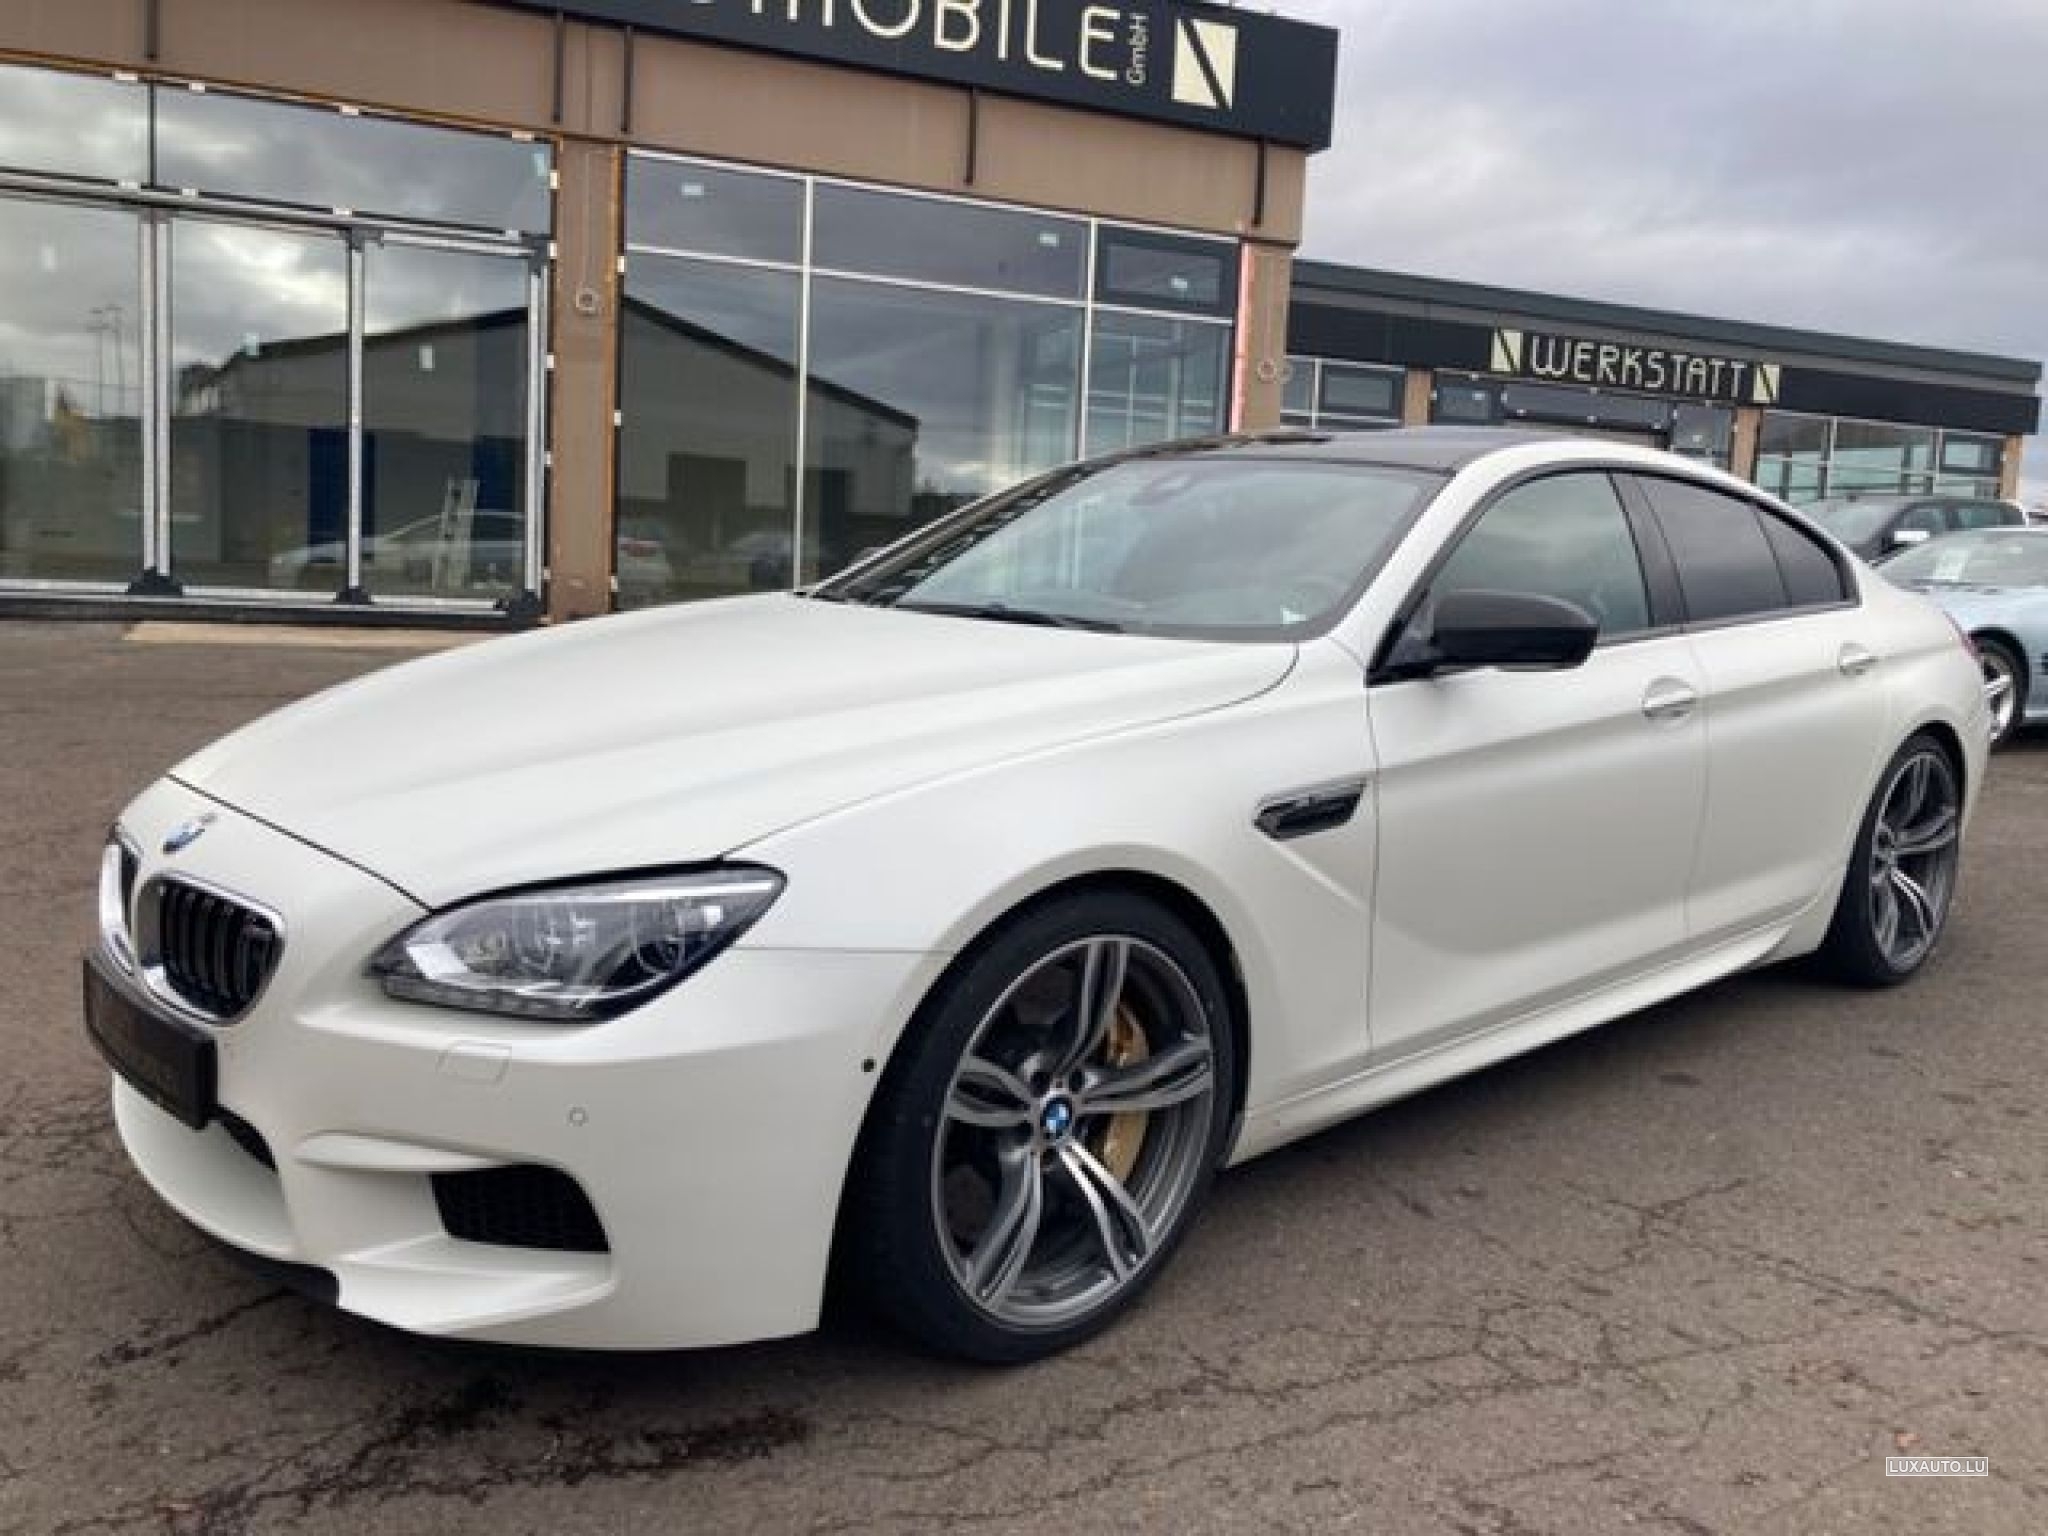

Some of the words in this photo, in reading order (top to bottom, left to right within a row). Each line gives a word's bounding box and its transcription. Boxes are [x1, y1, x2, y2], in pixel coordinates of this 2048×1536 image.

[687, 0, 1120, 81] OBILE
[1126, 12, 1149, 85] GmbH
[1532, 335, 1748, 398] WERKSTATT
